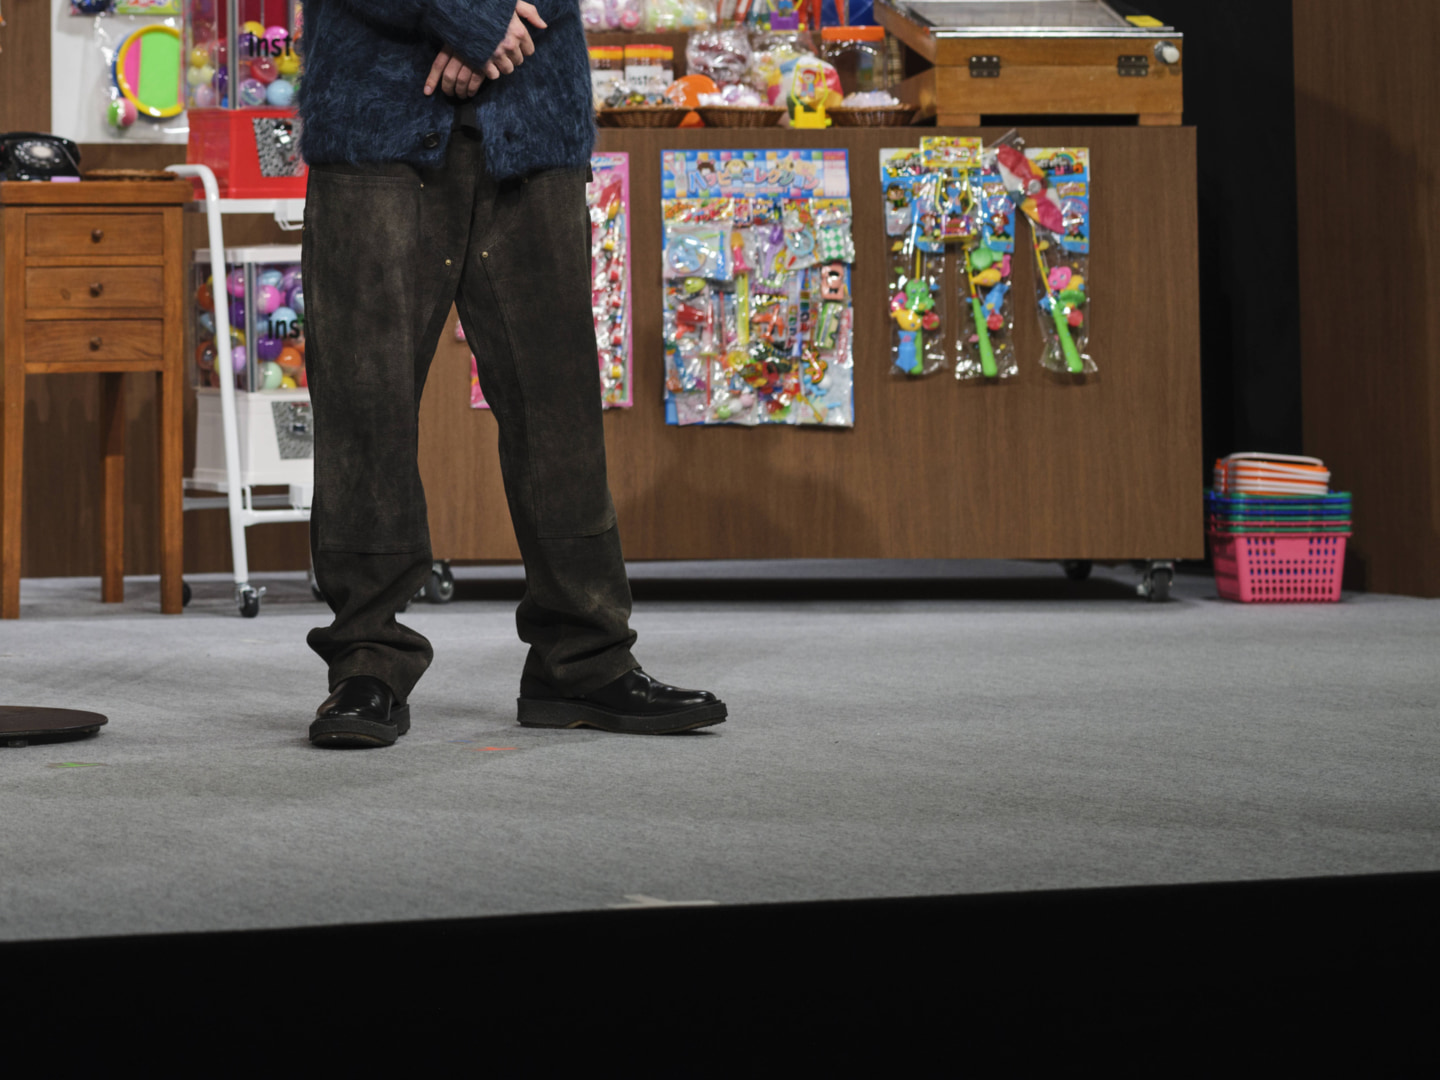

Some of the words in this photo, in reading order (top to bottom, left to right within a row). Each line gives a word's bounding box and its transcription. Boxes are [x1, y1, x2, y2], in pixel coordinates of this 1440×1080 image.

[249, 30, 296, 57] inst
[687, 167, 820, 195] ハッピーコレクション
[267, 312, 304, 339] ins
